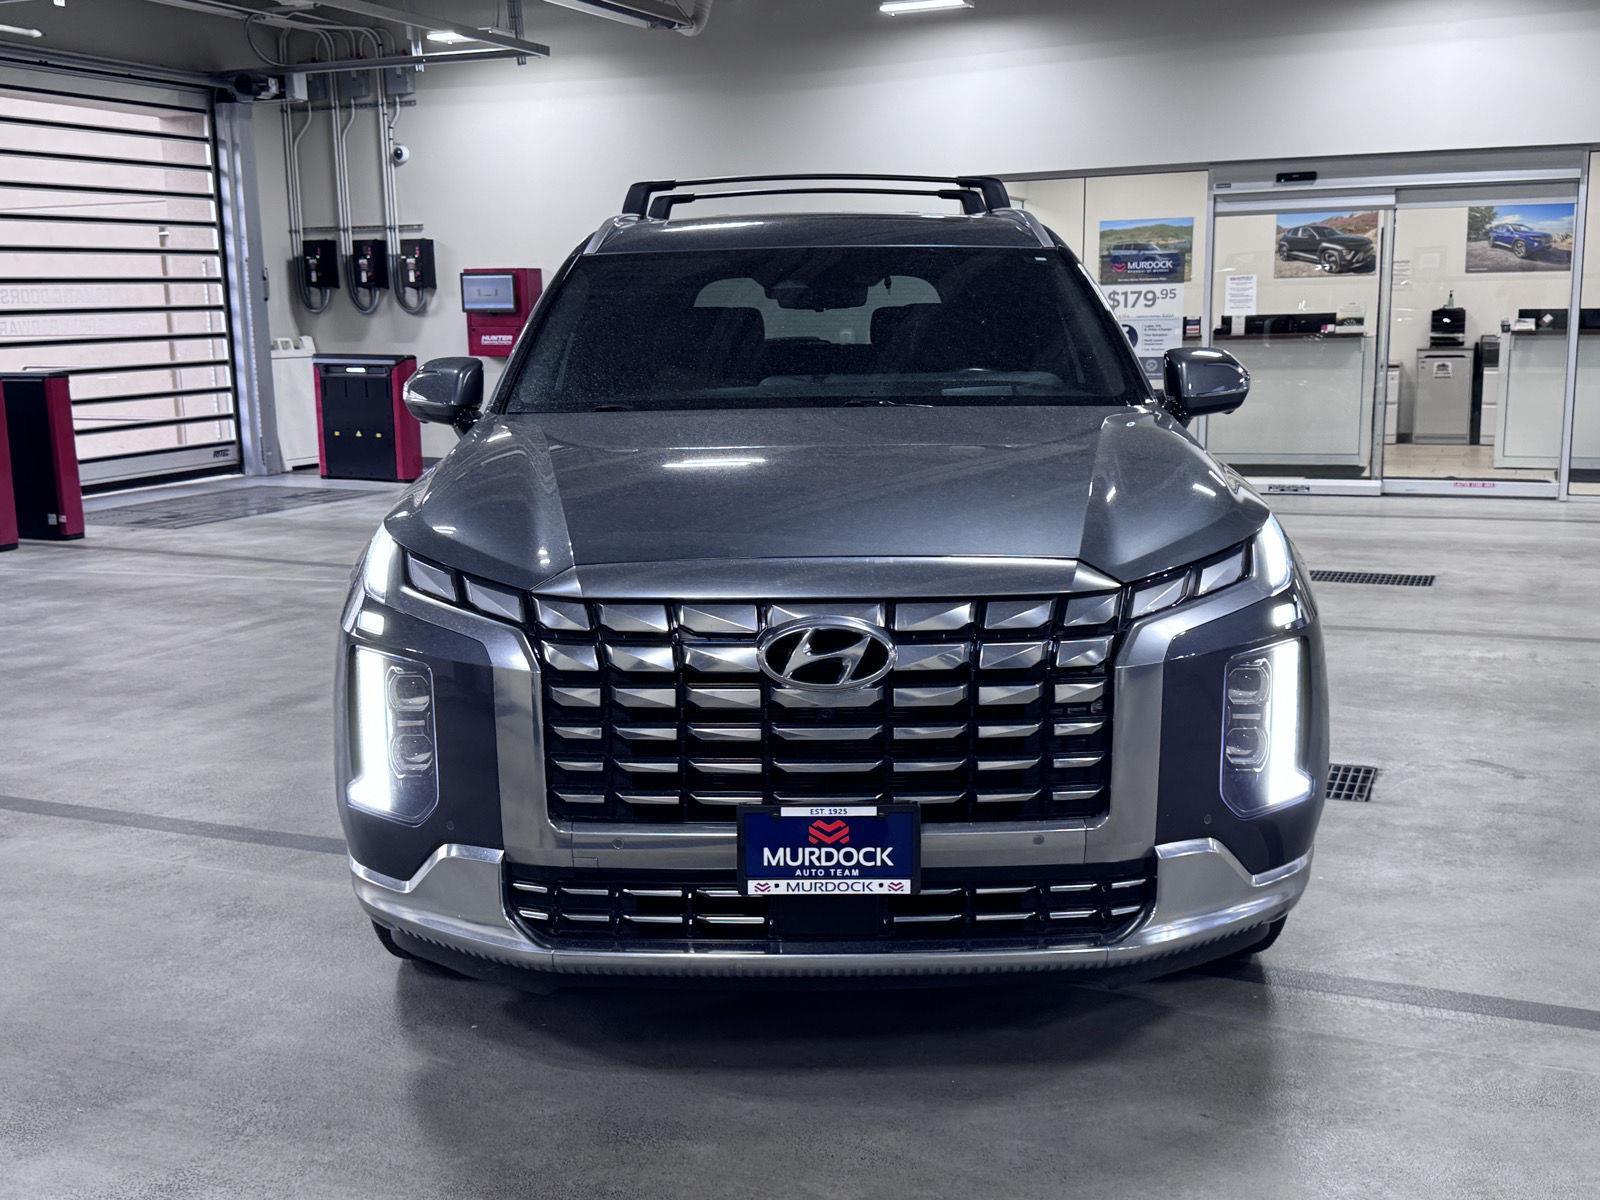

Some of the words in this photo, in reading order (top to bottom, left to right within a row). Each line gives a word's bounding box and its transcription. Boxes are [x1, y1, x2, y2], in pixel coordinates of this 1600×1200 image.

[1127, 260, 1173, 269] MURDOCK
[763, 846, 894, 867] MURDOCK
[795, 868, 825, 877] AUTO
[830, 868, 860, 877] TEAM
[786, 881, 874, 892] MURDOCK
